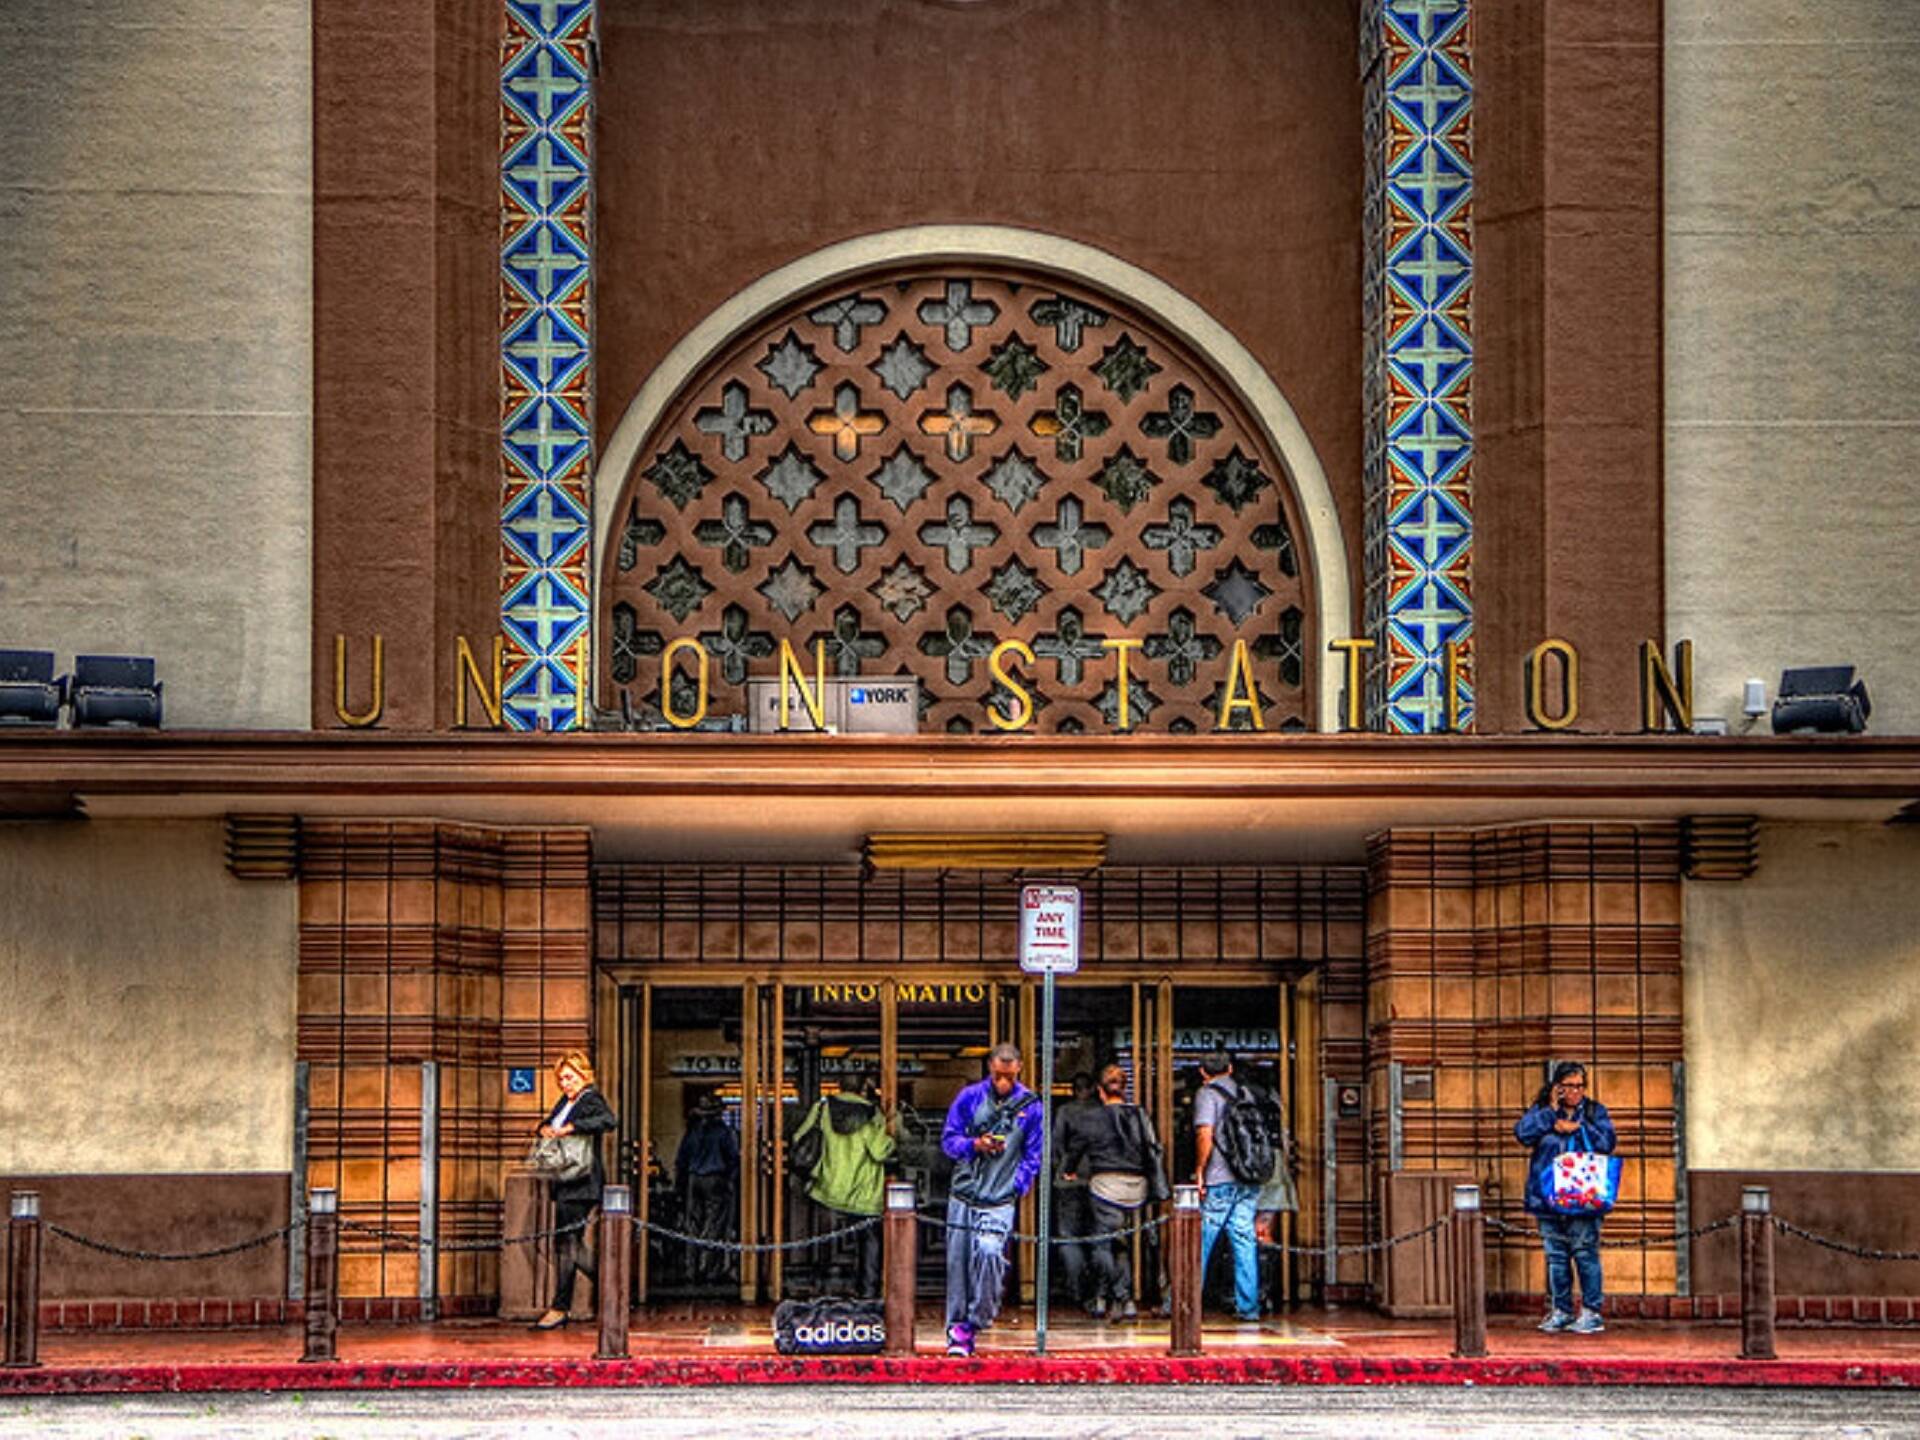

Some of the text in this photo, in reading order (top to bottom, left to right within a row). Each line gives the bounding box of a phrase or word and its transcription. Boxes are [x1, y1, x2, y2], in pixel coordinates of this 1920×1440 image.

[335, 633, 1693, 731] UNION STATION
[866, 687, 910, 703] YORK
[1037, 911, 1065, 922] ANY
[1035, 926, 1066, 938] TIME
[813, 984, 985, 1002] INFOMATIO
[794, 1320, 886, 1345] adidas
